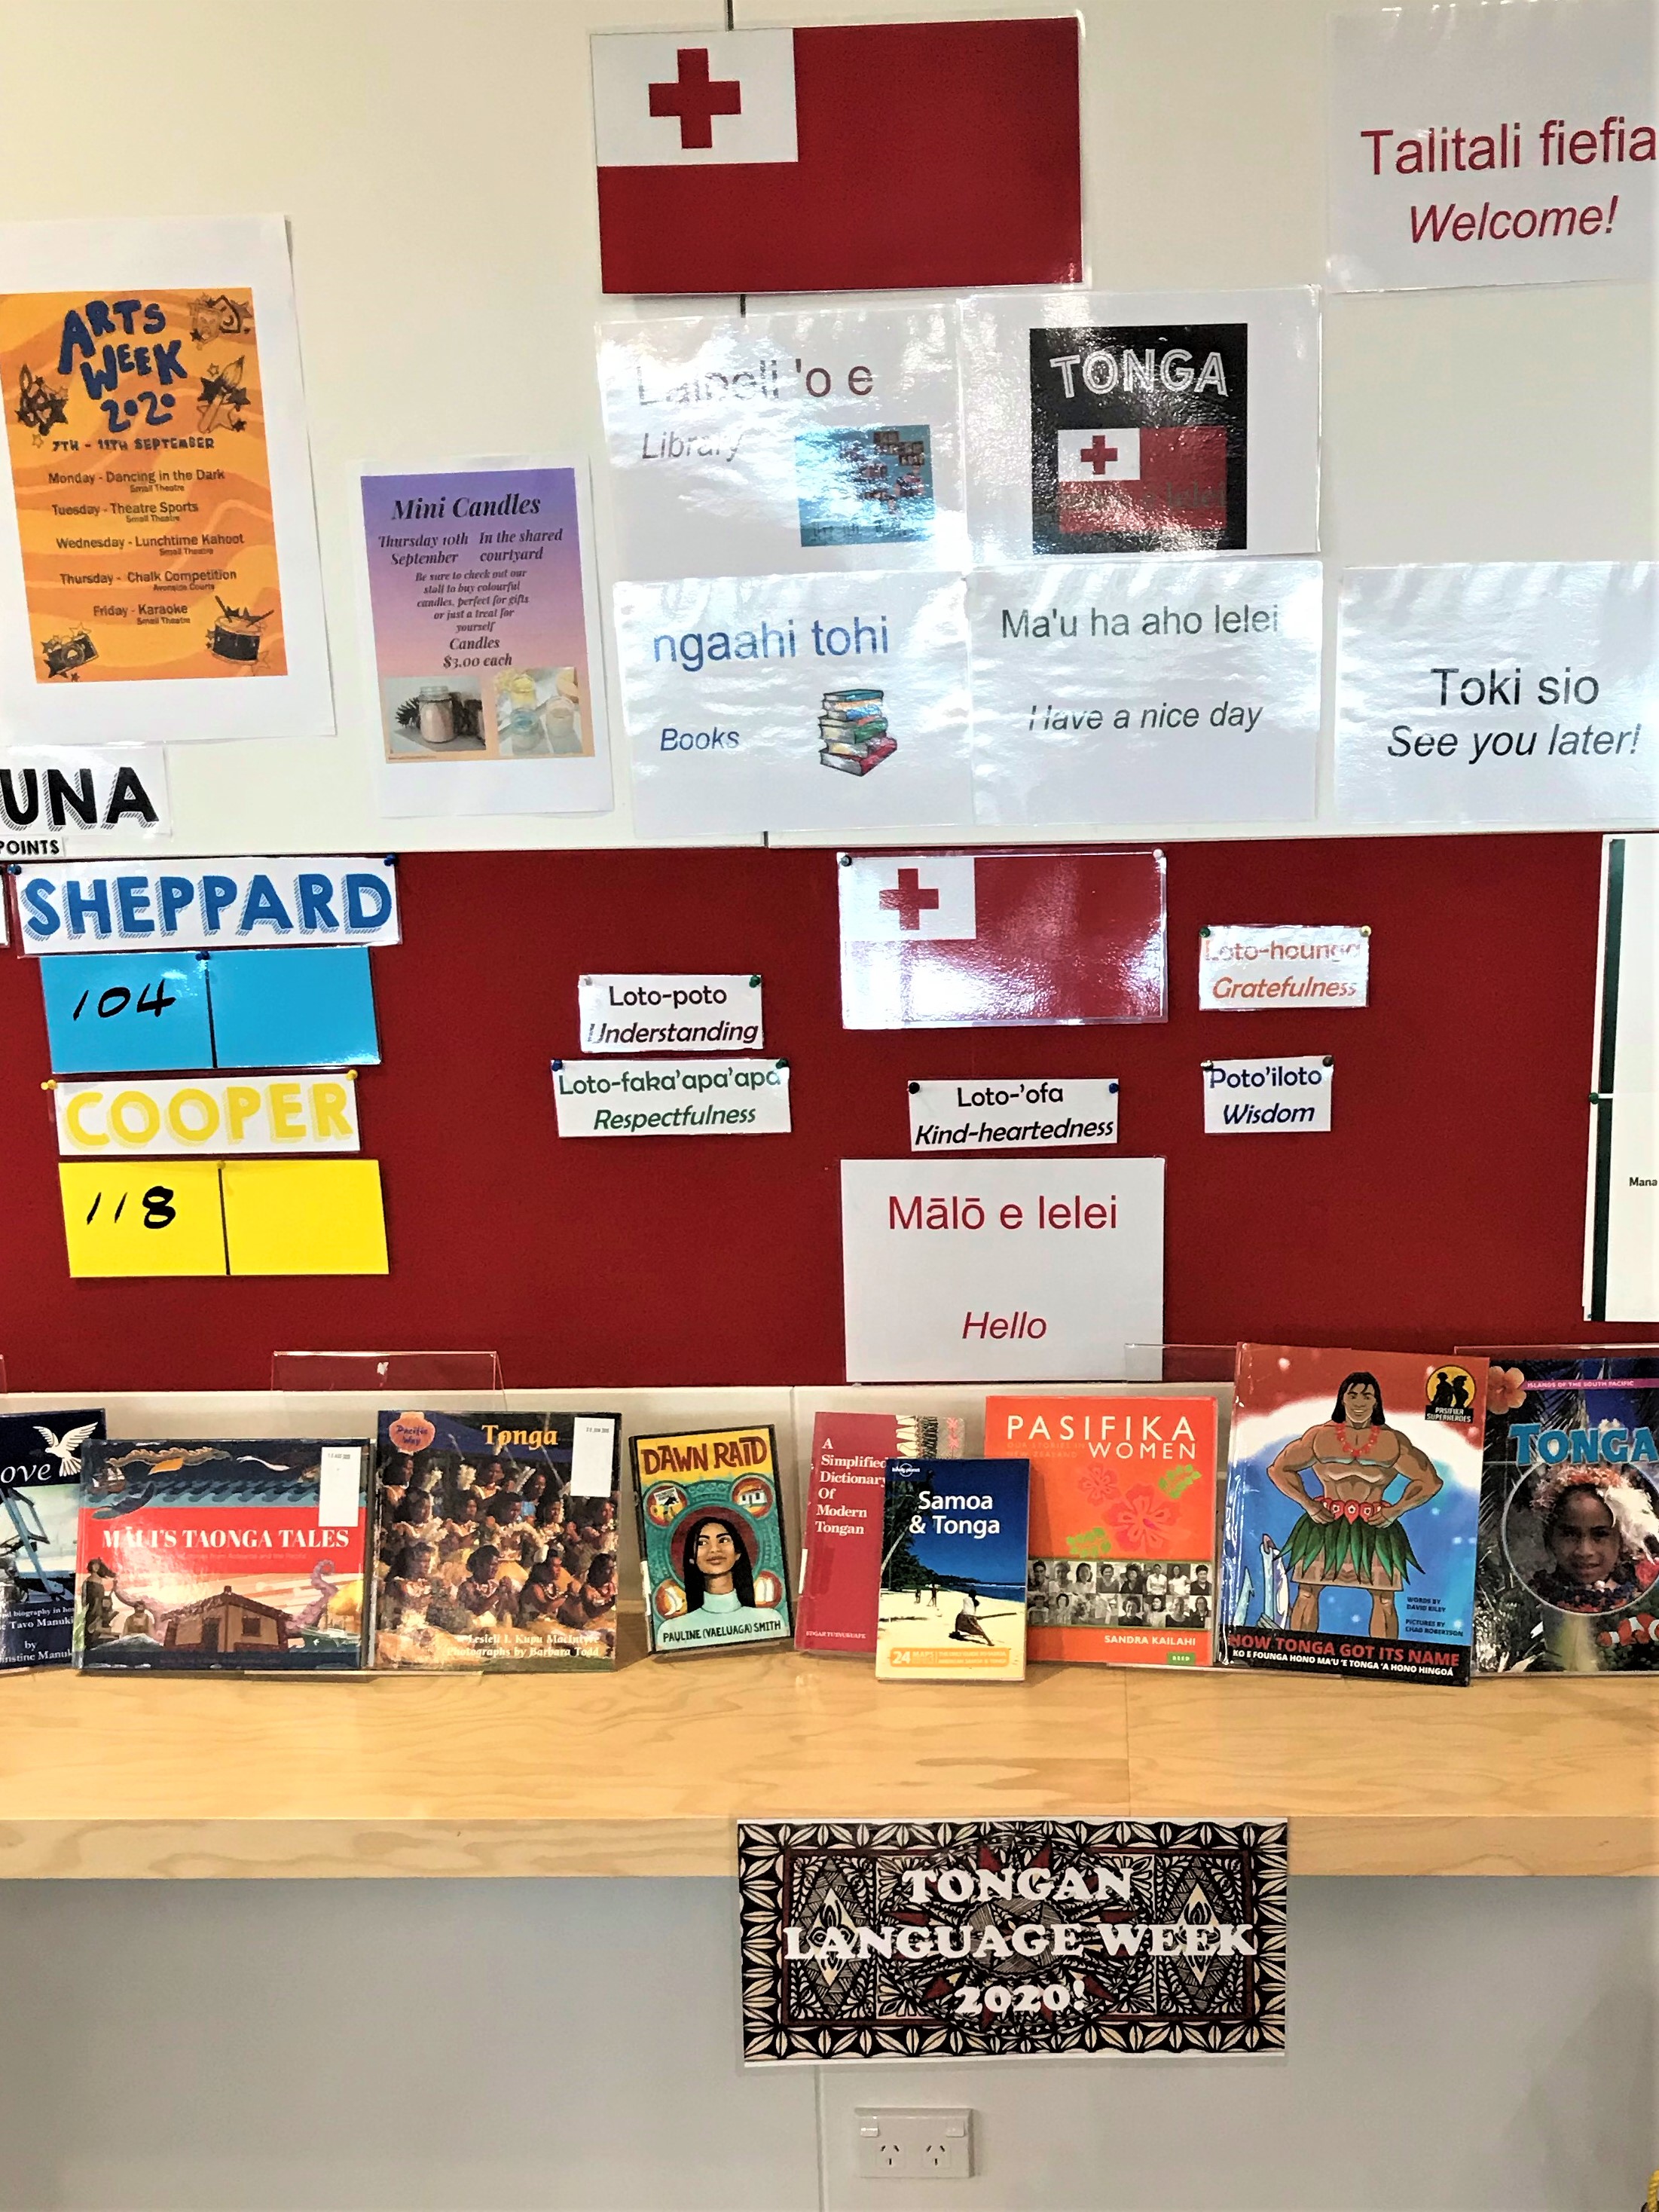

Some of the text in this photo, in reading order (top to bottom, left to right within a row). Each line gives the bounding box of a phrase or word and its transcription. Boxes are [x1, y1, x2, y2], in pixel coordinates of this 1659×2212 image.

[1361, 116, 1657, 176] Talitali fiefia
[1410, 194, 1619, 243] Welcome!
[58, 300, 166, 374] ARTS
[80, 339, 188, 400] WEEK
[848, 365, 874, 396] e
[1049, 348, 1229, 399] TONGA
[100, 391, 176, 433] 2020
[52, 440, 79, 451] 7TH
[134, 436, 215, 450] SEPTEMBER
[642, 431, 742, 462] Library
[48, 469, 225, 484] Monday Dancing in the Dark
[130, 484, 152, 493] Small
[52, 502, 199, 516] Tuesday Theatre Sports
[391, 493, 541, 521] Mini Candles
[57, 533, 244, 550] Wednesday Lunchtime Kahoot
[378, 535, 438, 548] Thursday
[479, 528, 564, 544] In the shared
[390, 551, 458, 567] September
[480, 547, 544, 563] courtyard
[60, 569, 237, 585] Thursday Chalk Competition
[416, 573, 427, 581] Be
[464, 570, 490, 579] check
[493, 570, 508, 579] out
[423, 581, 520, 594] stall buy colourful
[93, 603, 188, 617] Friday Karaoke
[457, 595, 490, 607] perfect
[493, 594, 507, 606] for
[509, 594, 530, 606] gifts
[447, 608, 515, 620] just treat for
[1001, 603, 1279, 639] Ma'u ha aho lelei
[457, 621, 496, 632] yourself
[449, 637, 500, 650] Candles
[653, 615, 889, 672] ngaahi tohi
[443, 652, 512, 669] $3.00 each
[1431, 666, 1599, 707] Toki sio
[1029, 701, 1263, 733] Have a nice day
[660, 726, 741, 751] Books
[1387, 723, 1642, 765] See you later!
[0, 766, 160, 832] UNA
[20, 872, 393, 941] SHEPPARD
[609, 985, 727, 1008] Loto-poto
[1212, 976, 1357, 998] Gratefulness
[72, 978, 176, 1021] 104
[587, 1020, 759, 1043] Understanding
[63, 1082, 357, 1150] COOPER
[593, 1104, 756, 1132] Respectfulness
[1223, 1102, 1315, 1124] Wisdom
[915, 1117, 1114, 1145] Kind-heartedness
[86, 1185, 176, 1230] 118
[889, 1195, 1117, 1230] Mālō e lelei
[962, 1311, 1046, 1340] Hello
[481, 1425, 558, 1450] Tonga
[1007, 1415, 1196, 1442] PASIFIKA
[641, 1435, 768, 1475] DAWN RAID
[821, 1438, 833, 1450] A
[1088, 1442, 1196, 1459] WOMEN
[1509, 1422, 1659, 1467] TONGA
[820, 1471, 886, 1487] Dictionary
[818, 1488, 836, 1500] Of
[918, 1490, 993, 1511] Samoa
[816, 1505, 868, 1518] Modern
[815, 1522, 865, 1536] Tongan
[909, 1514, 1000, 1538] & Tonga
[182, 1529, 273, 1548] TAONGA
[279, 1529, 350, 1548] TALES
[14, 1609, 50, 1617] biography
[663, 1621, 781, 1642] PAULINE SMITH
[1104, 1635, 1196, 1646] SANDRA KAILAHI
[1425, 1628, 1463, 1636] ROBERTSON
[24, 1641, 38, 1651] by
[1229, 1633, 1459, 1667] HOW TONGA GOT ITS NAME
[893, 1651, 910, 1664] 24
[1253, 1651, 1288, 1661] FOUNGA
[1290, 1655, 1316, 1664] HONO
[1349, 1660, 1379, 1670] TONGA
[1391, 1664, 1417, 1673] HONO
[902, 1866, 1134, 1904] TONGAN
[783, 1923, 1260, 1961] LANGUAGE WEEK
[953, 1978, 1087, 2015] 2020!
